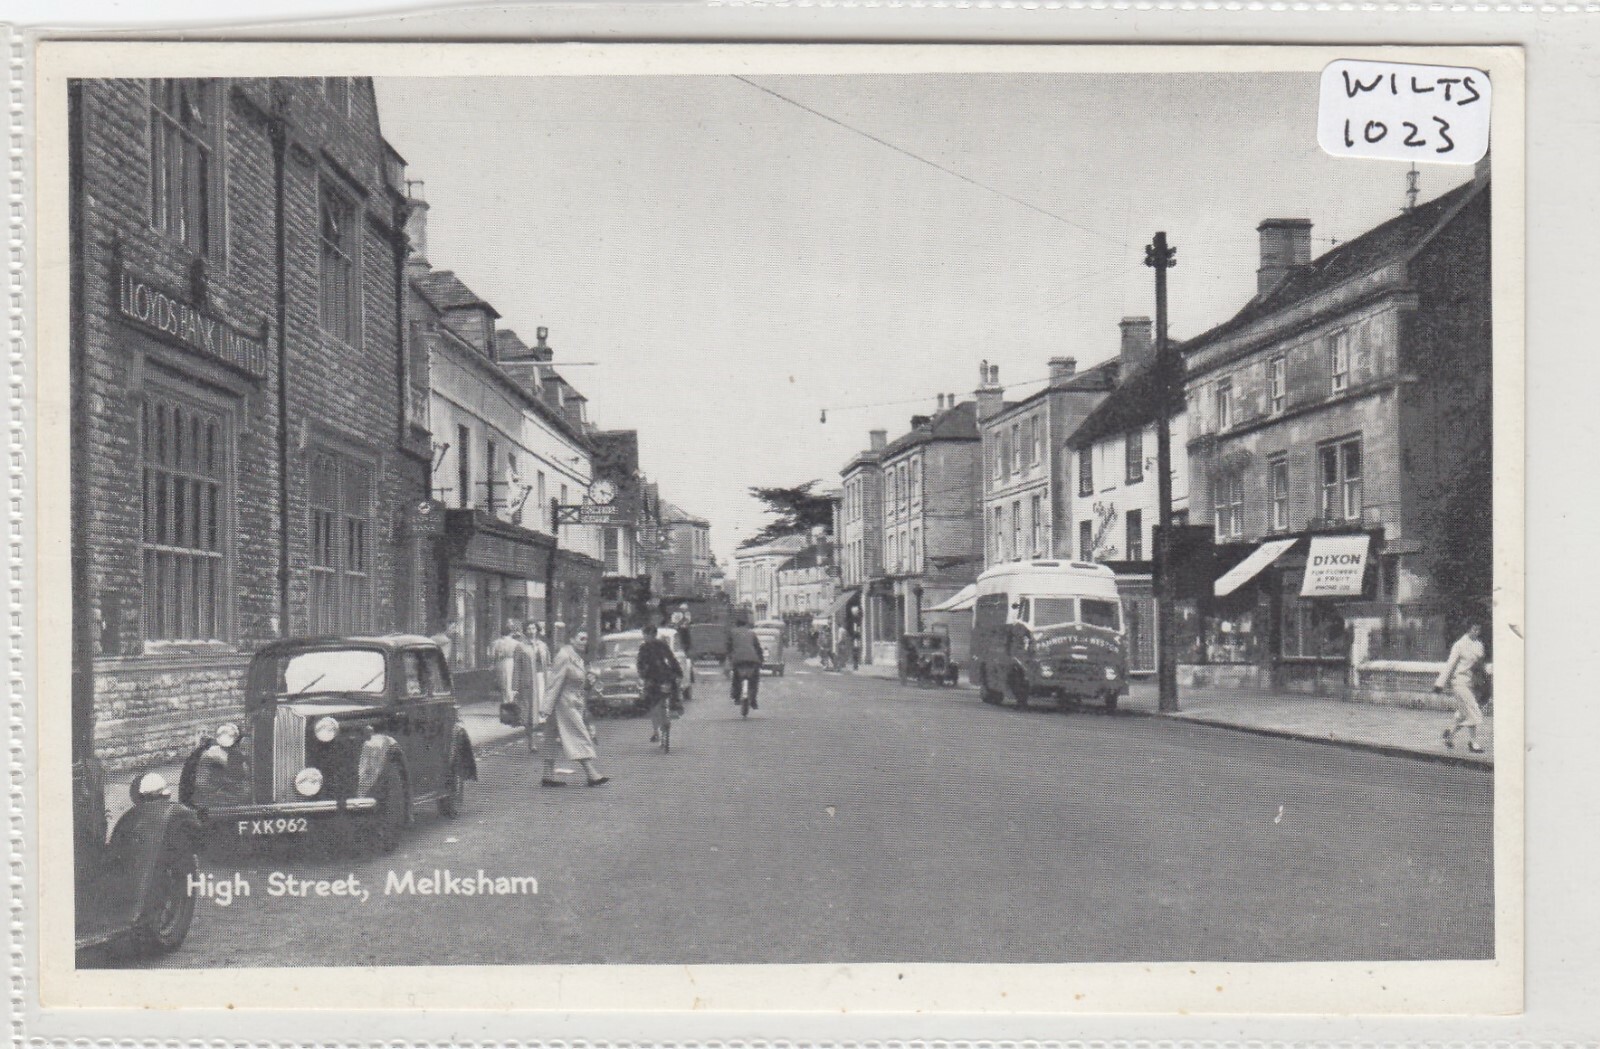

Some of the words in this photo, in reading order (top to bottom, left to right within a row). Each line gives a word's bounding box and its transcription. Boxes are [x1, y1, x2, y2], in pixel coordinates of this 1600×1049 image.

[1342, 69, 1480, 106] WILTS
[1344, 115, 1455, 153] 1023
[120, 273, 178, 336] LLOYDS
[180, 304, 217, 355] BANK
[1313, 554, 1361, 566] DIXON
[237, 818, 308, 835] FXK962
